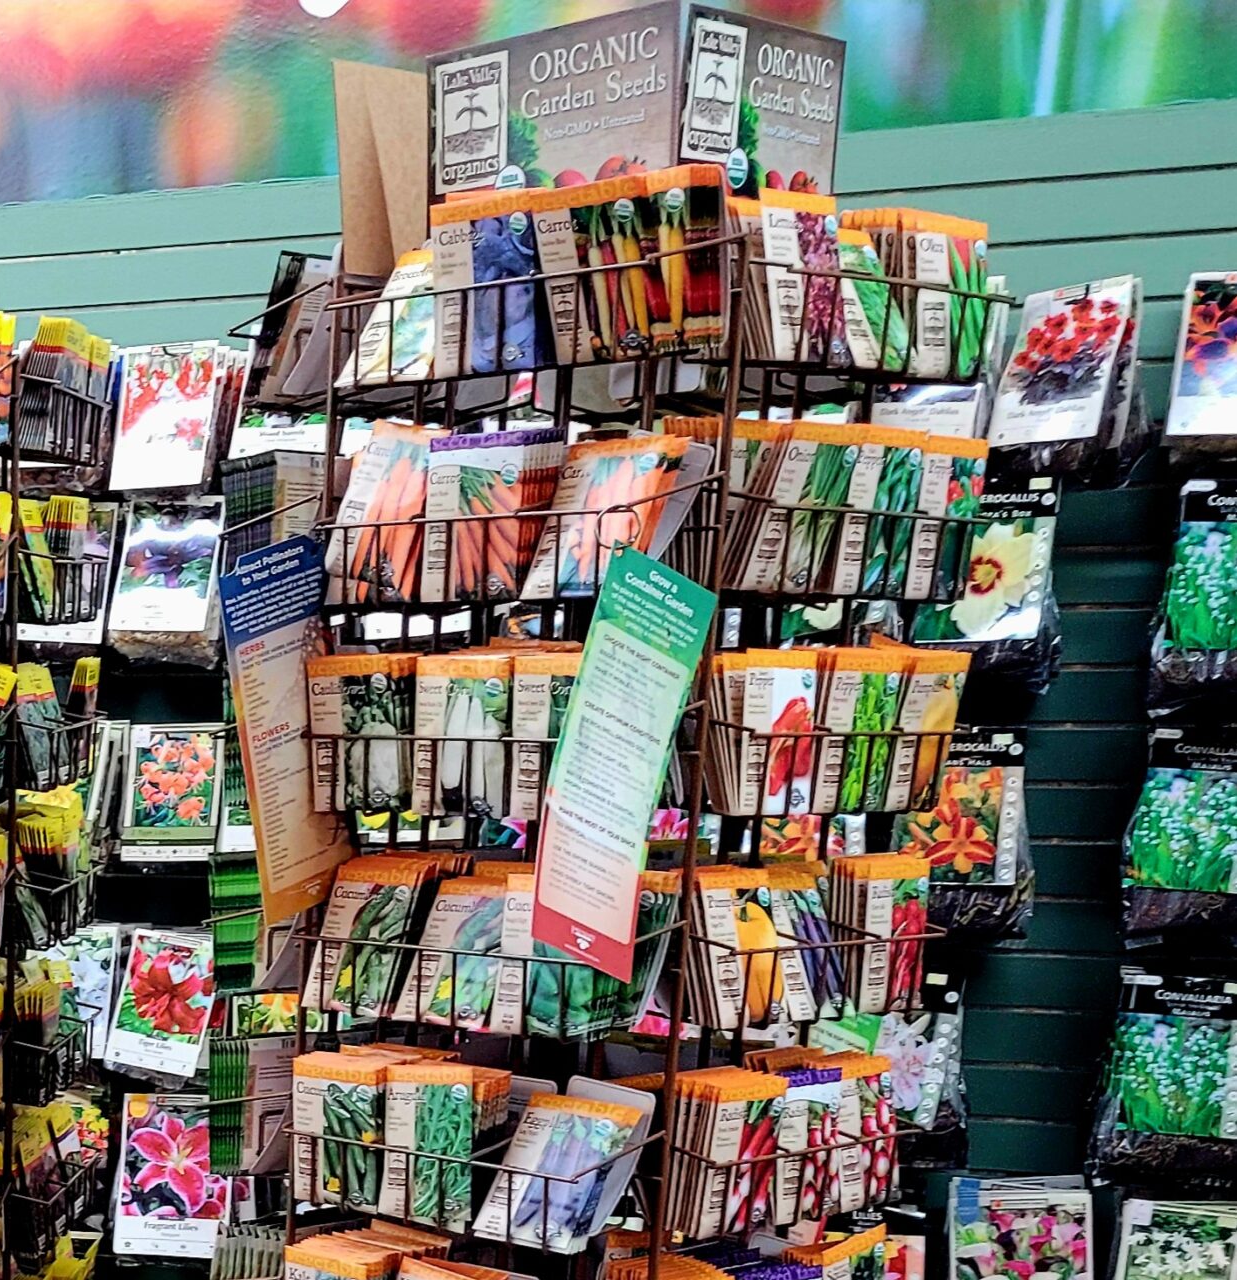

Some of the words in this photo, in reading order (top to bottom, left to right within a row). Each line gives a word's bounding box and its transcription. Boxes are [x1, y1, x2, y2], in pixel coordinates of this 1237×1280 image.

[530, 27, 659, 83] ORGANIC
[699, 32, 718, 49] Lake
[718, 34, 740, 58] Valley
[757, 43, 834, 89] ORGANIC
[443, 72, 467, 90] Lake
[468, 65, 500, 85] Valley
[520, 85, 595, 119] Garden
[606, 69, 667, 103] Seeds
[747, 77, 795, 111] Garden
[799, 95, 834, 123] Seeds
[544, 119, 592, 142] Non-GMO
[688, 130, 732, 153] organics
[442, 156, 500, 182] organics
[537, 219, 579, 236] Carrot
[980, 493, 1039, 504] EROCALLIS
[261, 544, 305, 565] Pollinators
[240, 575, 251, 585] to
[251, 569, 270, 581] Your
[269, 558, 300, 575] Garden
[647, 569, 673, 590] Grow
[623, 571, 666, 601] Container
[662, 593, 696, 618] Garden
[237, 640, 266, 657] HERBS
[418, 681, 443, 695] Sweet
[518, 679, 545, 694] Sweet
[250, 721, 292, 743] FLOWERS
[1174, 743, 1237, 756] CONVALLA
[1154, 989, 1233, 1005] CONVALLARIA
[144, 1221, 176, 1231] Fragrant
[179, 1222, 199, 1232] Lilies
